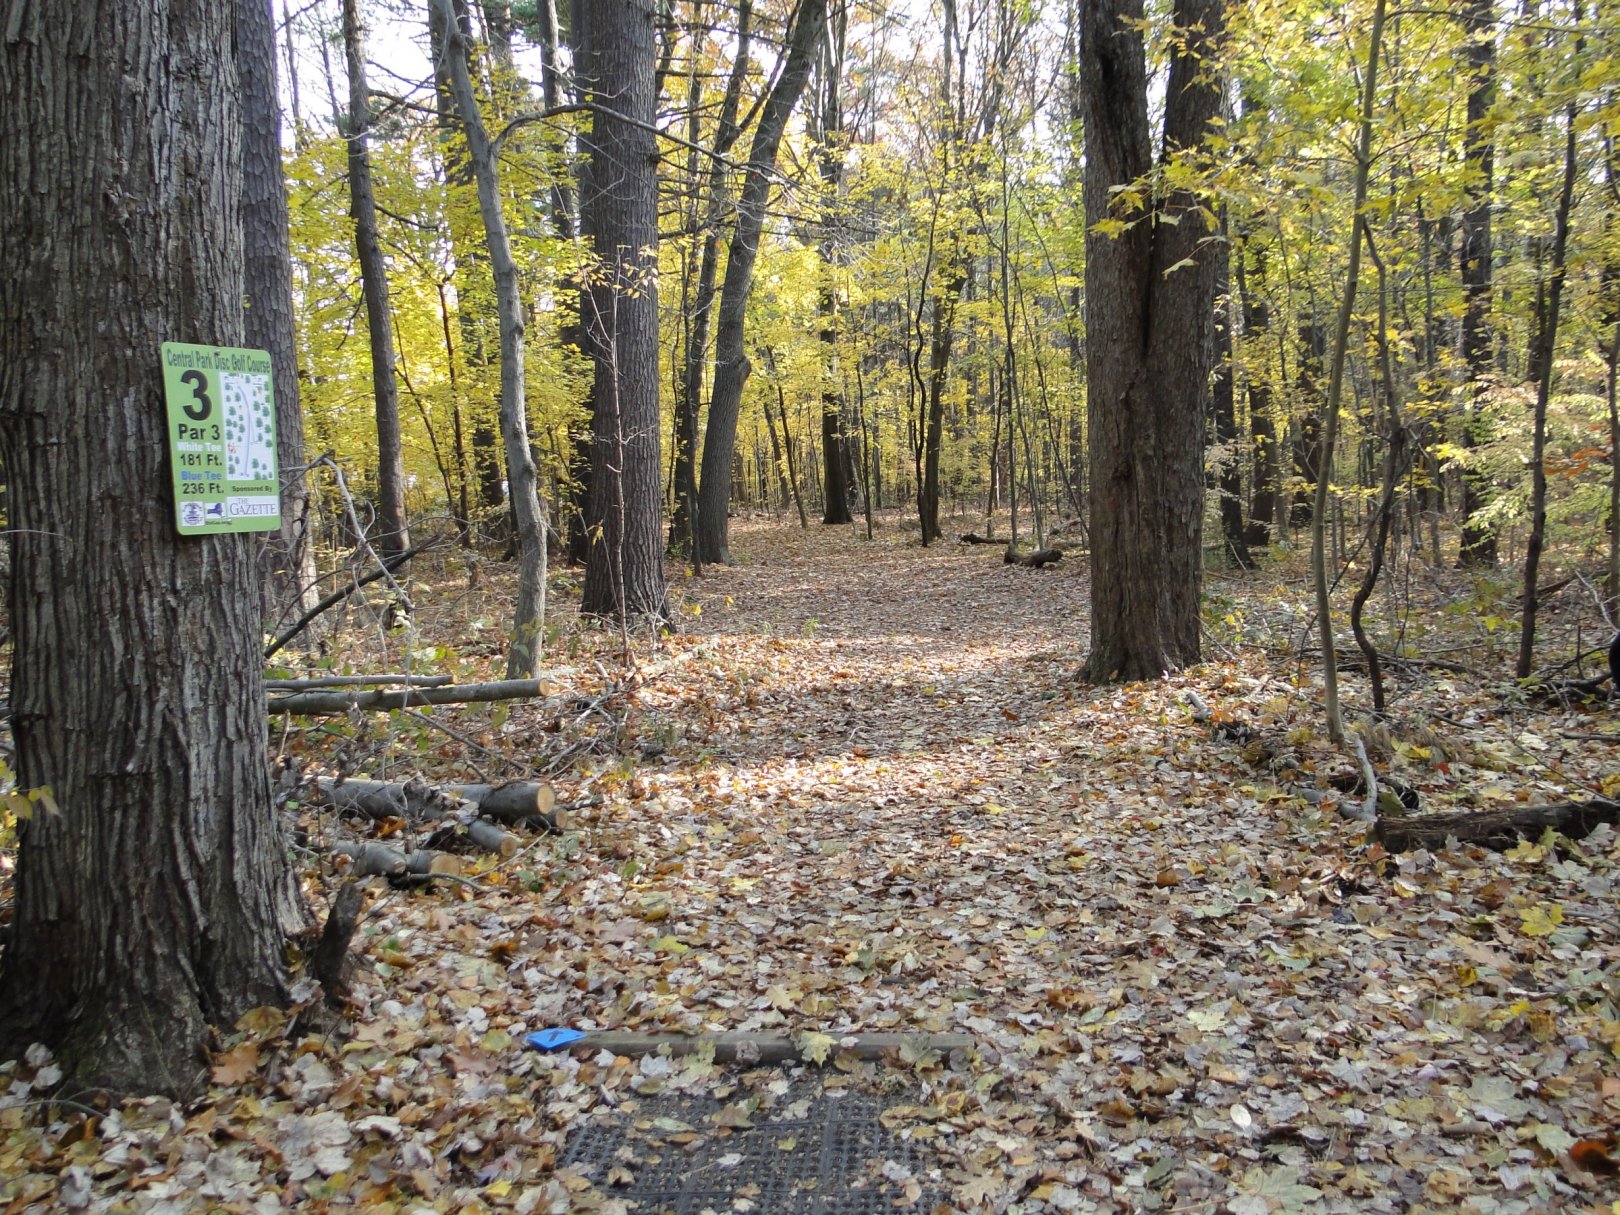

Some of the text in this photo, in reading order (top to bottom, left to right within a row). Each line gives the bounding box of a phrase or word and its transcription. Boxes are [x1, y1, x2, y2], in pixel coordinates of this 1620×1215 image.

[166, 348, 270, 373] Central Park Disc Golf Course
[181, 370, 212, 421] 3
[178, 424, 220, 440] Par 3
[176, 441, 222, 452] White Tee
[180, 454, 222, 466] 181 Ft.
[181, 470, 222, 480] Blue Tee
[182, 482, 224, 494] 236 Ft.
[232, 485, 264, 493] Sponsored
[230, 503, 276, 516] GAZETTE
